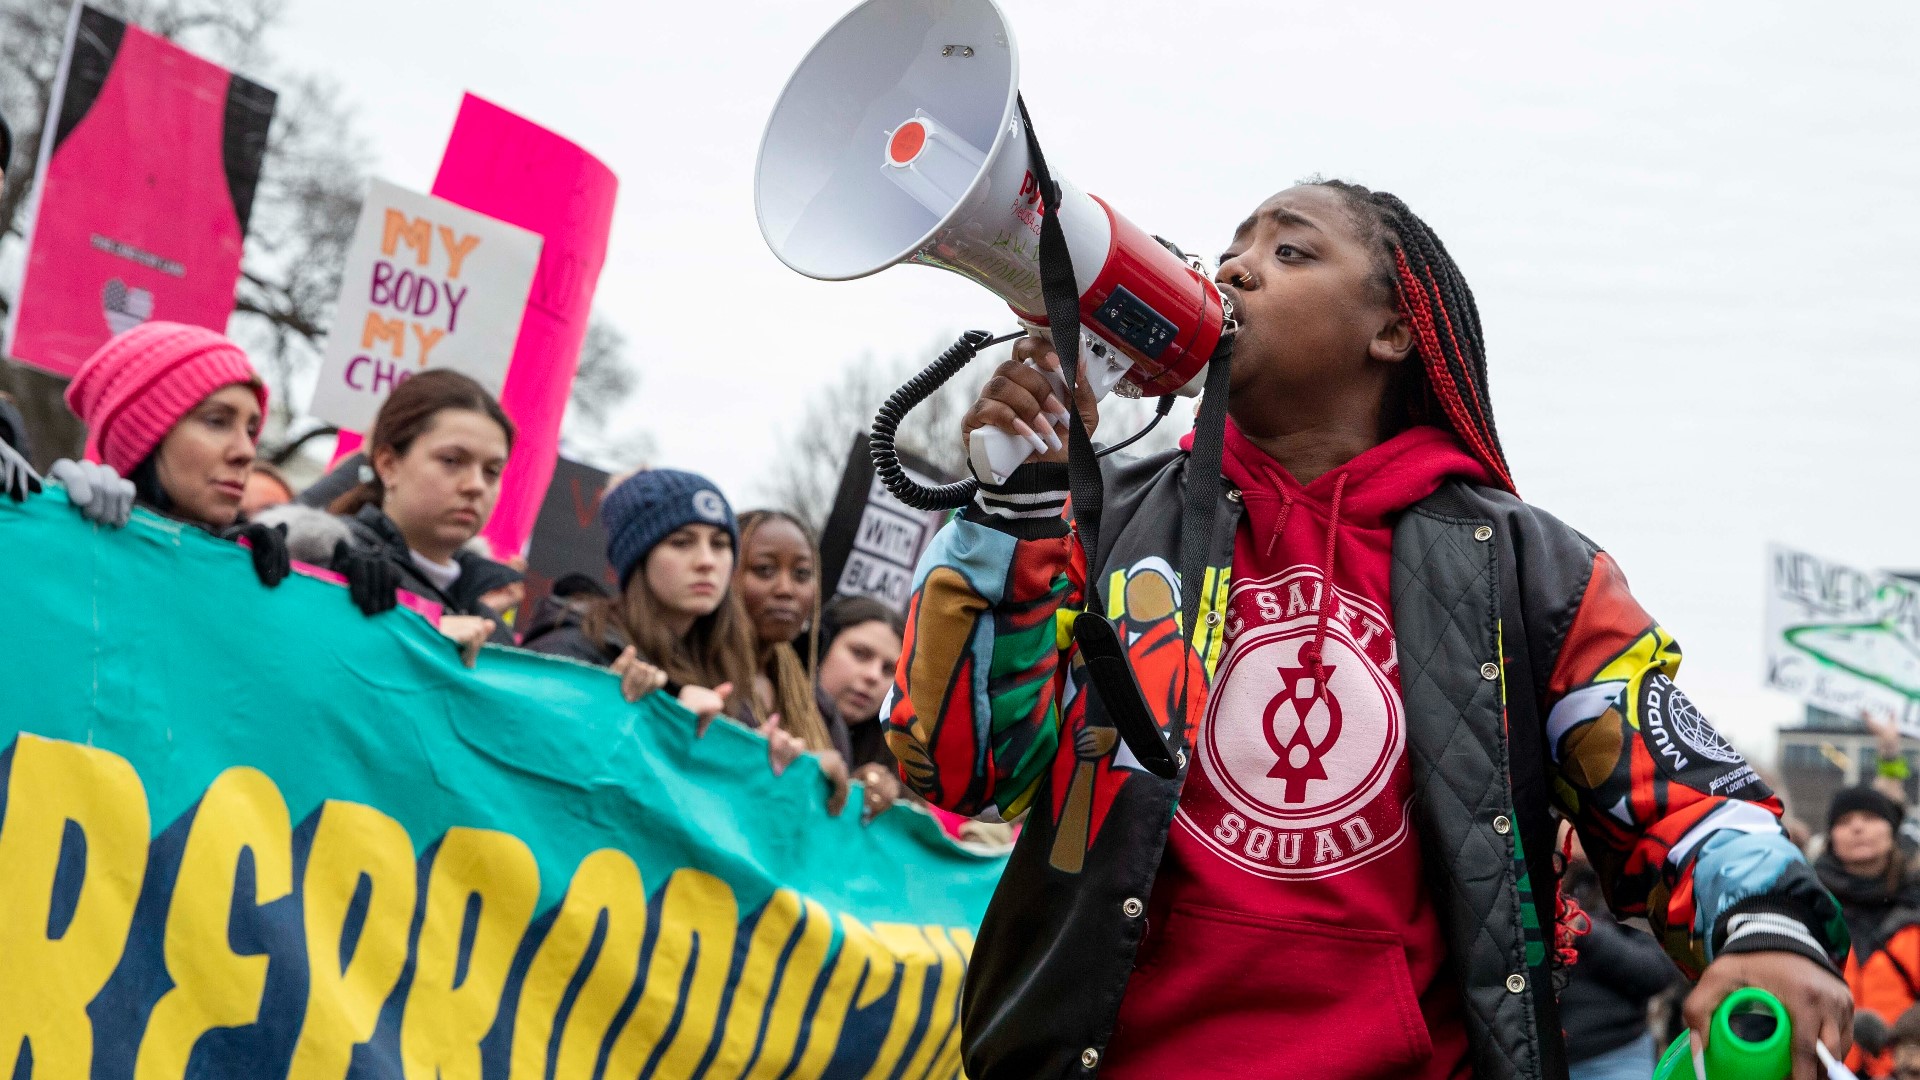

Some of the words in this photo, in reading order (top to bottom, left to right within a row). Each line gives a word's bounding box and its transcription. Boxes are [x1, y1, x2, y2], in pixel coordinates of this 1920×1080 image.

[380, 206, 481, 280] MY
[1010, 198, 1041, 236] PyleUSA.co
[369, 259, 468, 334] BODY
[361, 310, 447, 367] MY
[845, 558, 909, 602] BLAC
[1213, 811, 1375, 865] SQUAD
